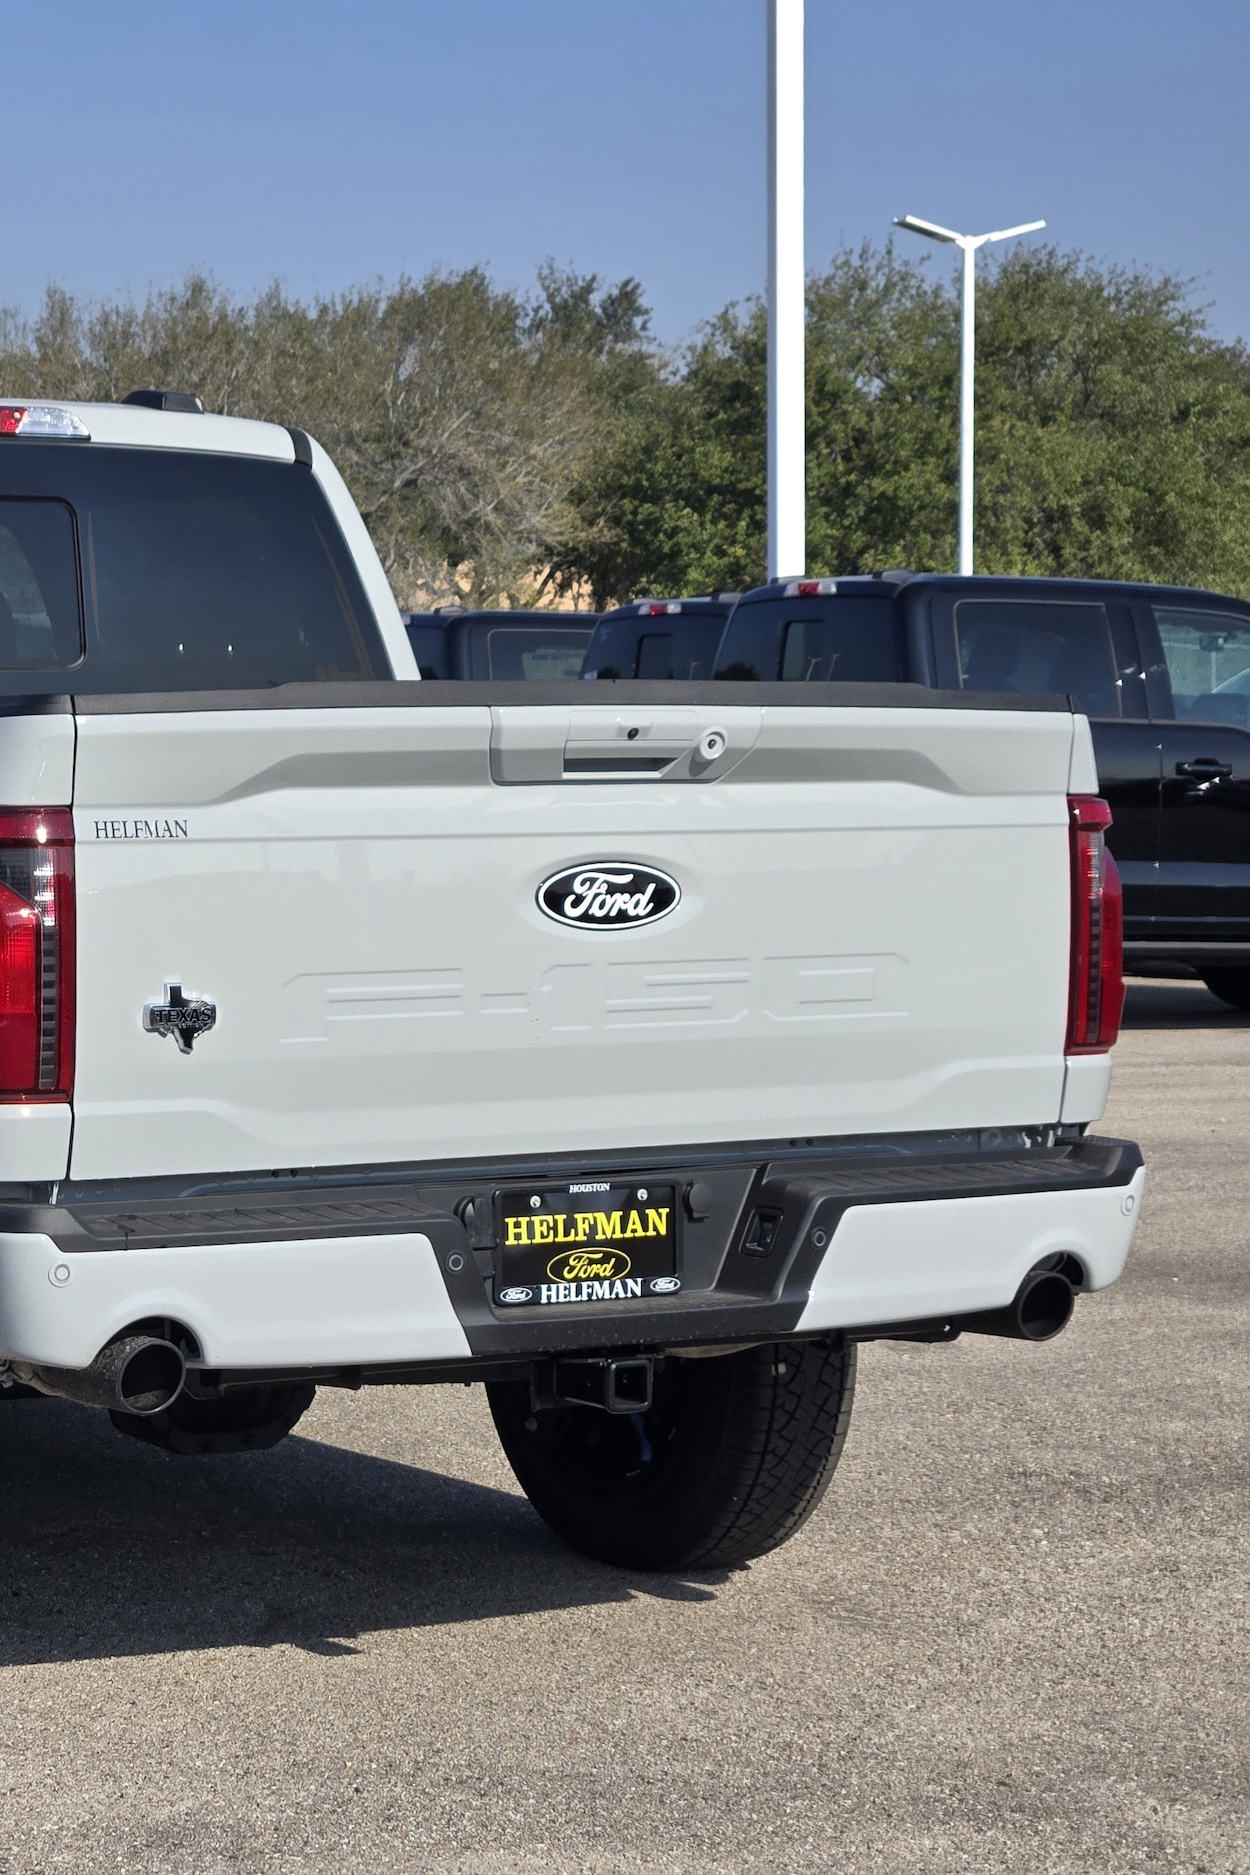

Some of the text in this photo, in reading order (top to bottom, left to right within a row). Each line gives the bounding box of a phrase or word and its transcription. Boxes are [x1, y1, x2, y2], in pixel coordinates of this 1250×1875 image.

[94, 819, 188, 838] HELFMAN
[563, 872, 656, 917] Ford
[155, 1007, 212, 1023] TEXAS
[569, 1183, 611, 1193] HOUSTON
[505, 1208, 670, 1245] HELFMAN
[563, 1252, 616, 1280] Ford
[540, 1278, 643, 1304] HELFMAN
